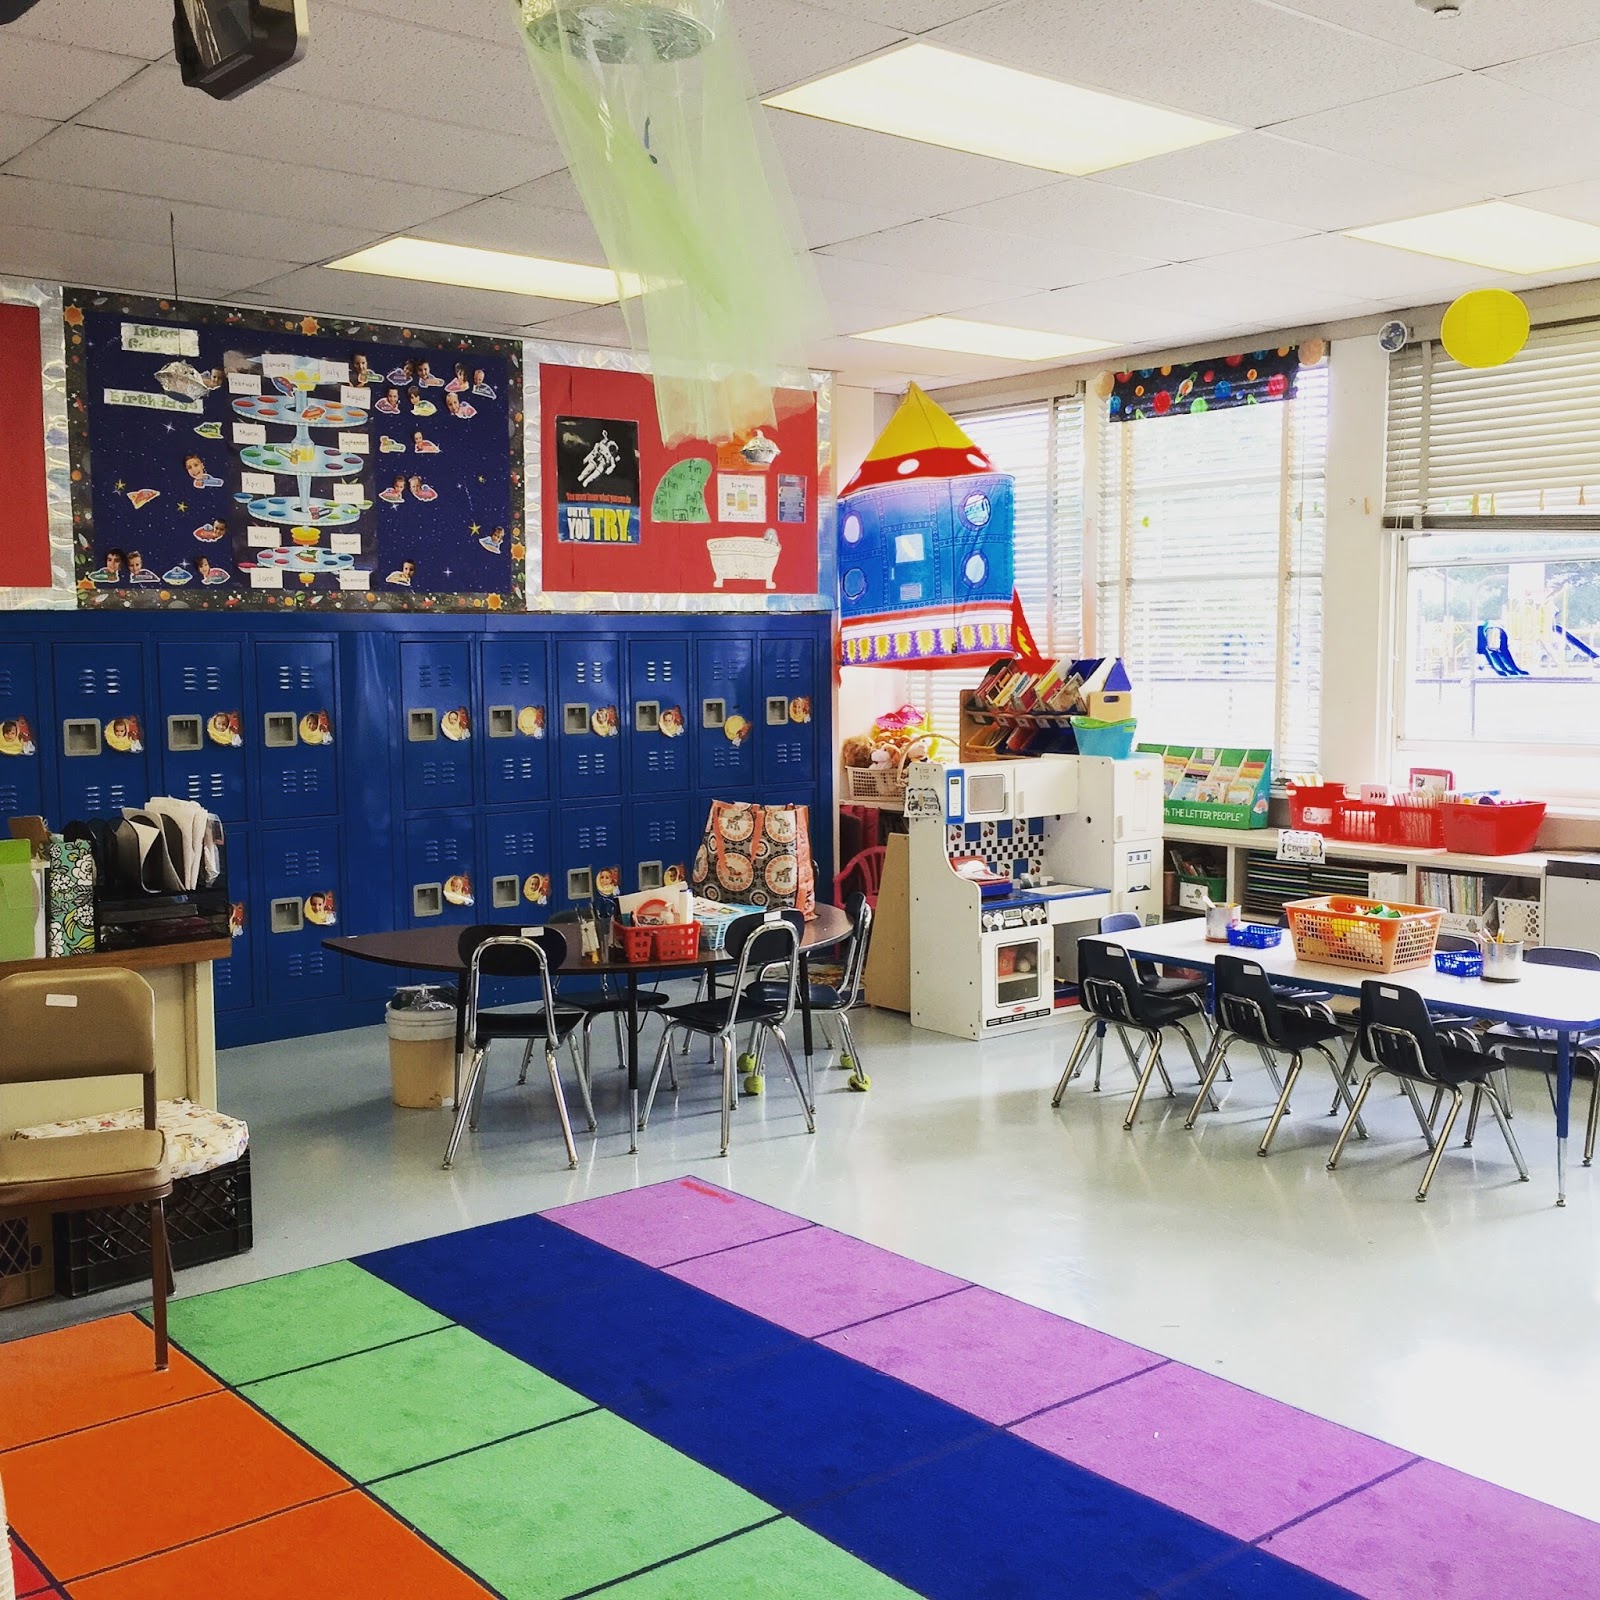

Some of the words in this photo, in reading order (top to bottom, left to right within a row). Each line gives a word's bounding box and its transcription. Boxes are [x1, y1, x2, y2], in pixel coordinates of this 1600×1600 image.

[567, 506, 590, 518] UNTIL
[590, 507, 632, 542] TRY.
[567, 517, 591, 540] YOU
[1171, 807, 1185, 818] THE
[1185, 808, 1212, 821] LETTER
